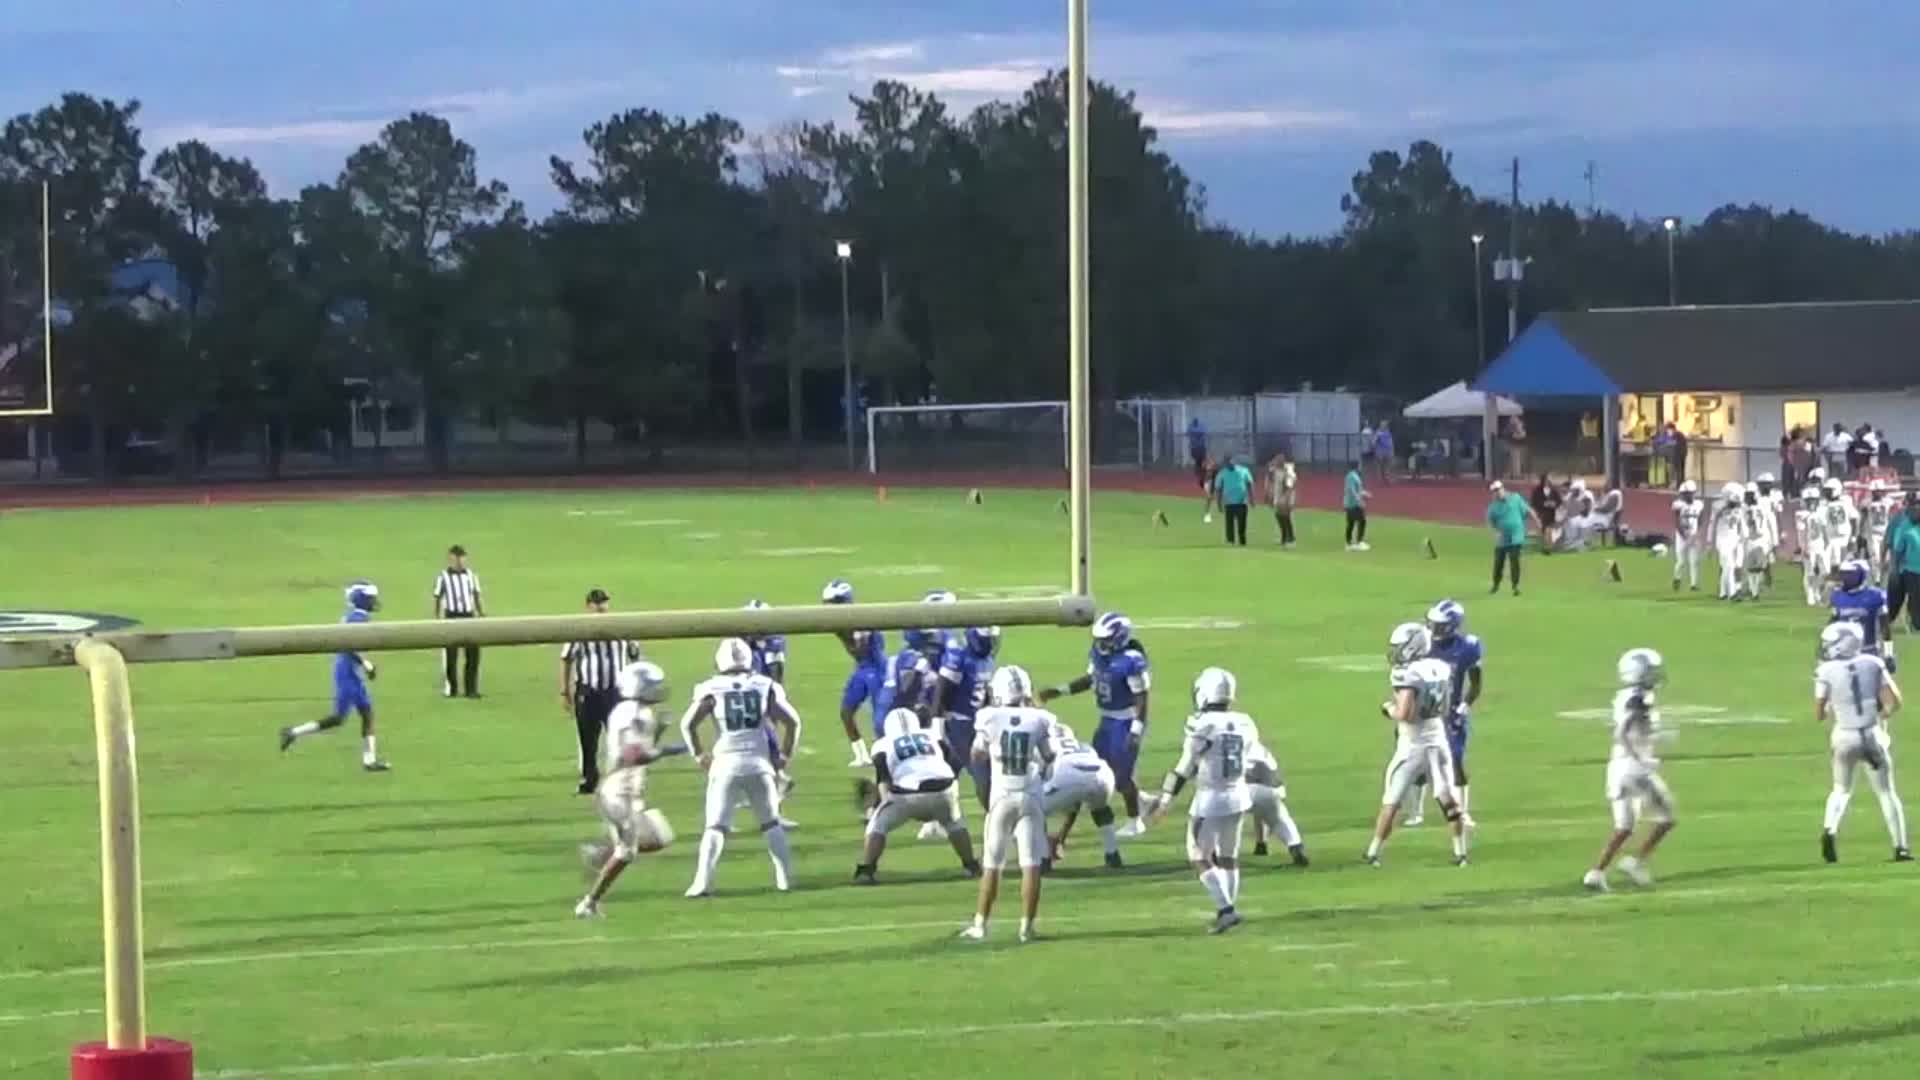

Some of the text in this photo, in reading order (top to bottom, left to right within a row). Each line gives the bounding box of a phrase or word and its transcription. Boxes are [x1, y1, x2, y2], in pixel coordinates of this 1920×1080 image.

[724, 690, 762, 732] 69
[1850, 673, 1862, 716] 1
[893, 733, 936, 761] 66
[1000, 730, 1032, 776] 10
